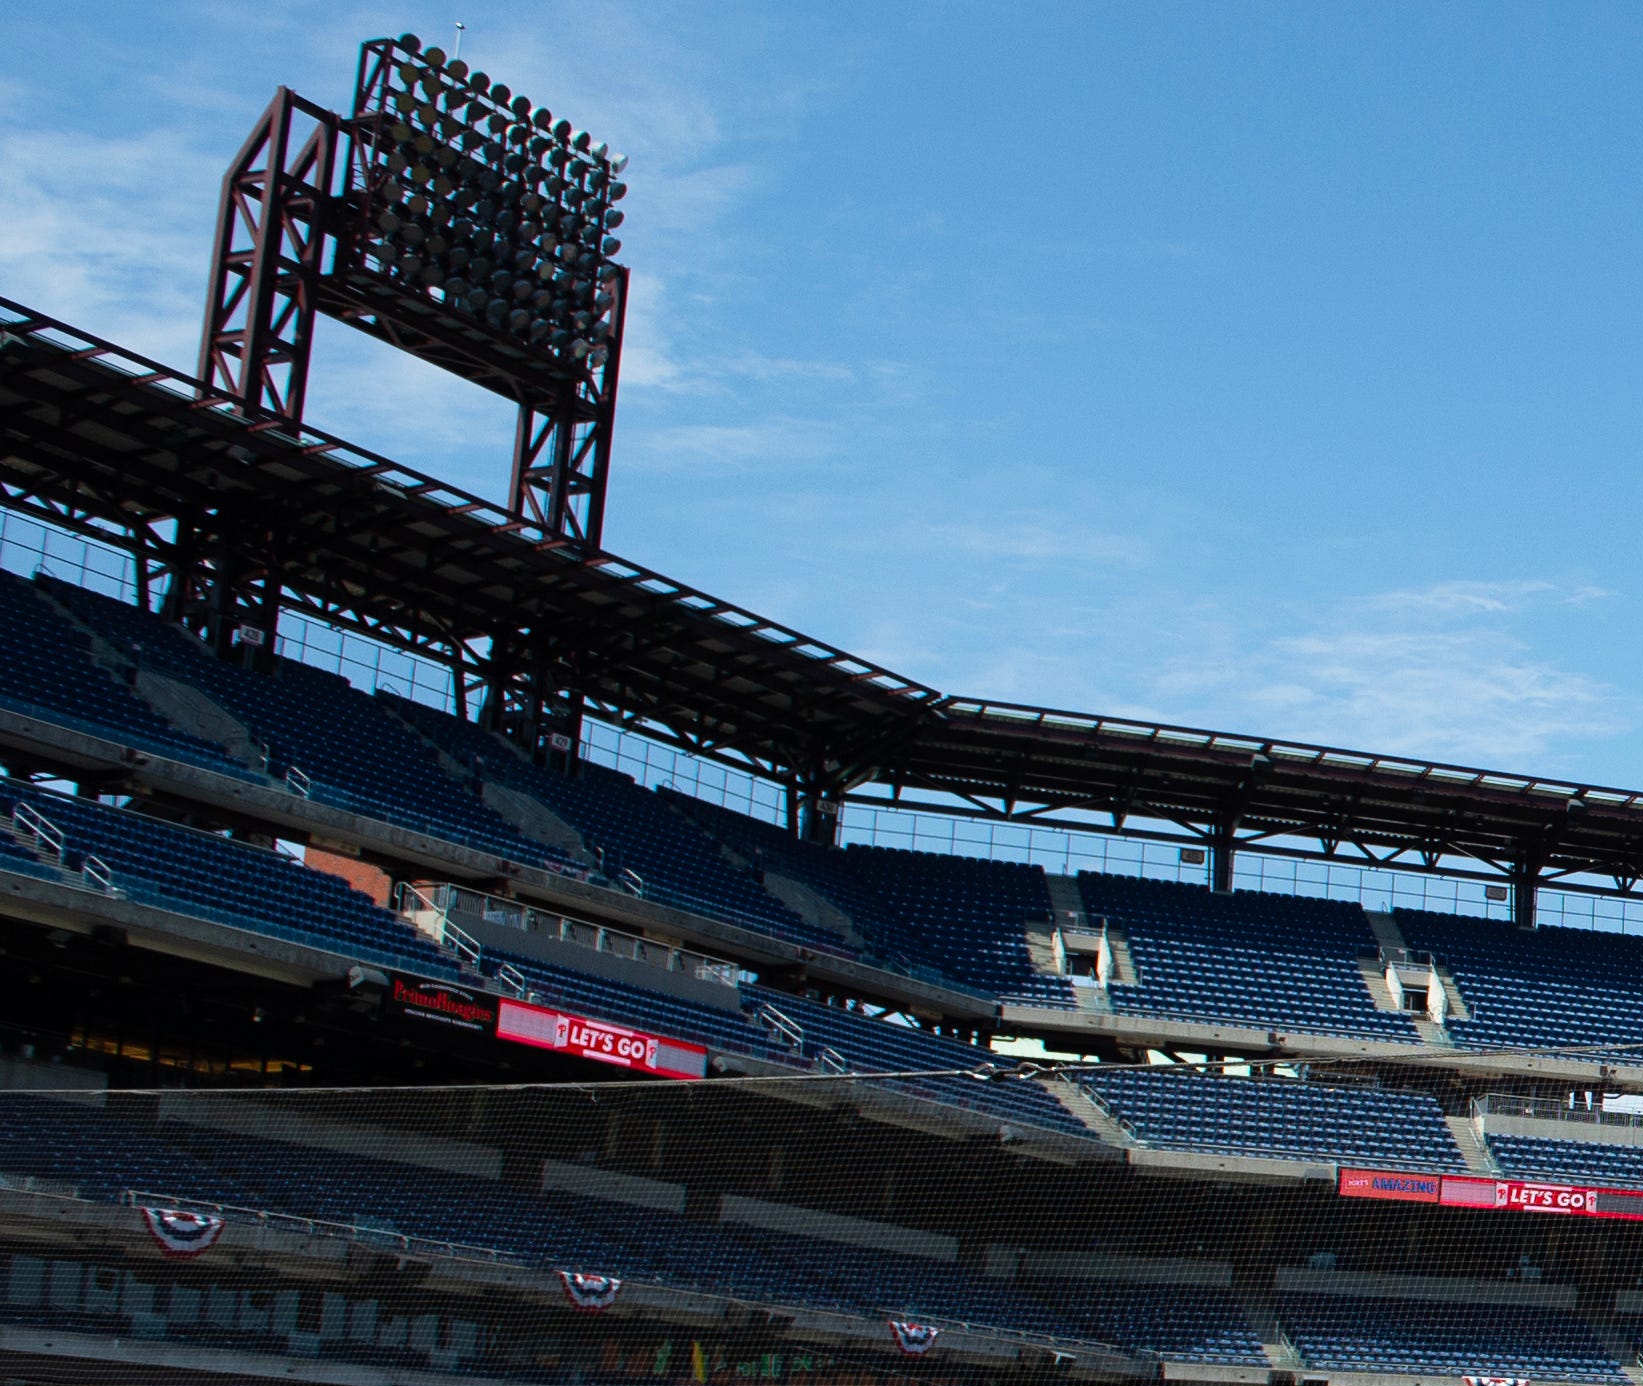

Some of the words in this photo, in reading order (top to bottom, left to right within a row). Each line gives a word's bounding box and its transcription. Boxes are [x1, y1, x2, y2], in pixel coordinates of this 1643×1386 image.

[570, 1025, 613, 1052] LET'S
[617, 1034, 645, 1059] GO
[1511, 1187, 1552, 1205] LET'S
[1558, 1193, 1585, 1208] GO
